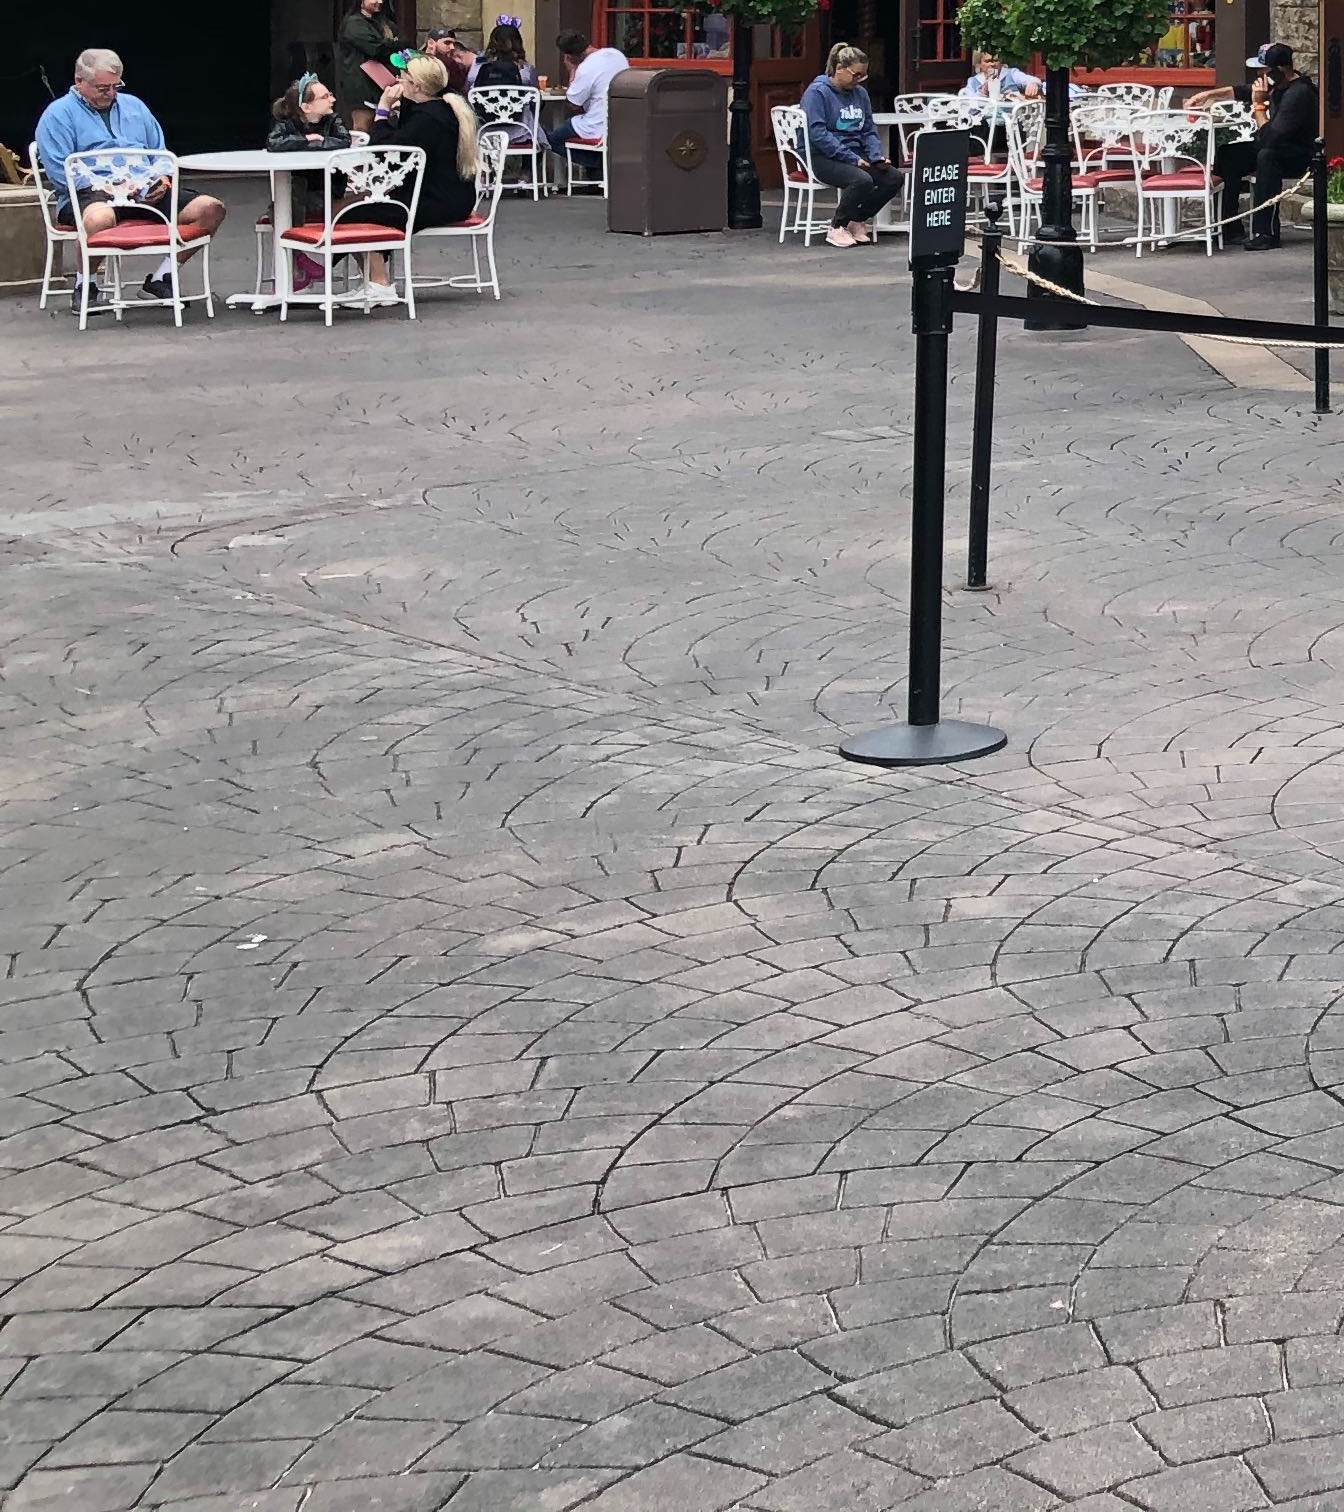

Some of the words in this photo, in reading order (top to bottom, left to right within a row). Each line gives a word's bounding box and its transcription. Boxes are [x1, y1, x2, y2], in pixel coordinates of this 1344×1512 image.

[922, 164, 960, 183] PLEASE
[924, 187, 955, 206] ENTER
[926, 209, 951, 227] HERE
